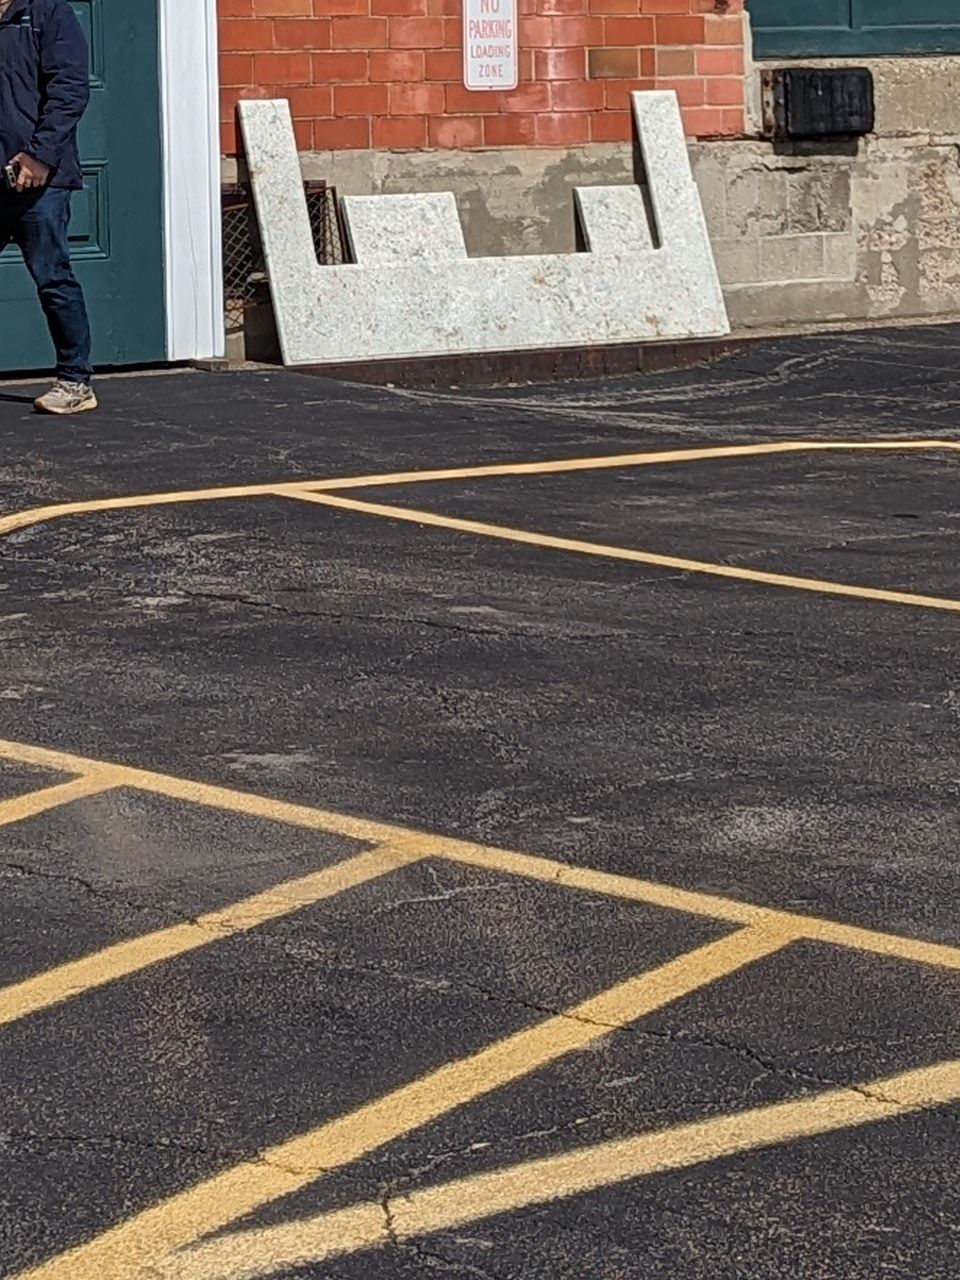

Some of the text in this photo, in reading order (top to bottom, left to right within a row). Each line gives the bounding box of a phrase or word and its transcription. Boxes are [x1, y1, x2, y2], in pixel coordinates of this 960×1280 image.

[469, 19, 512, 39] PARKING
[470, 44, 511, 58] LOADING
[479, 63, 503, 78] ZONE
